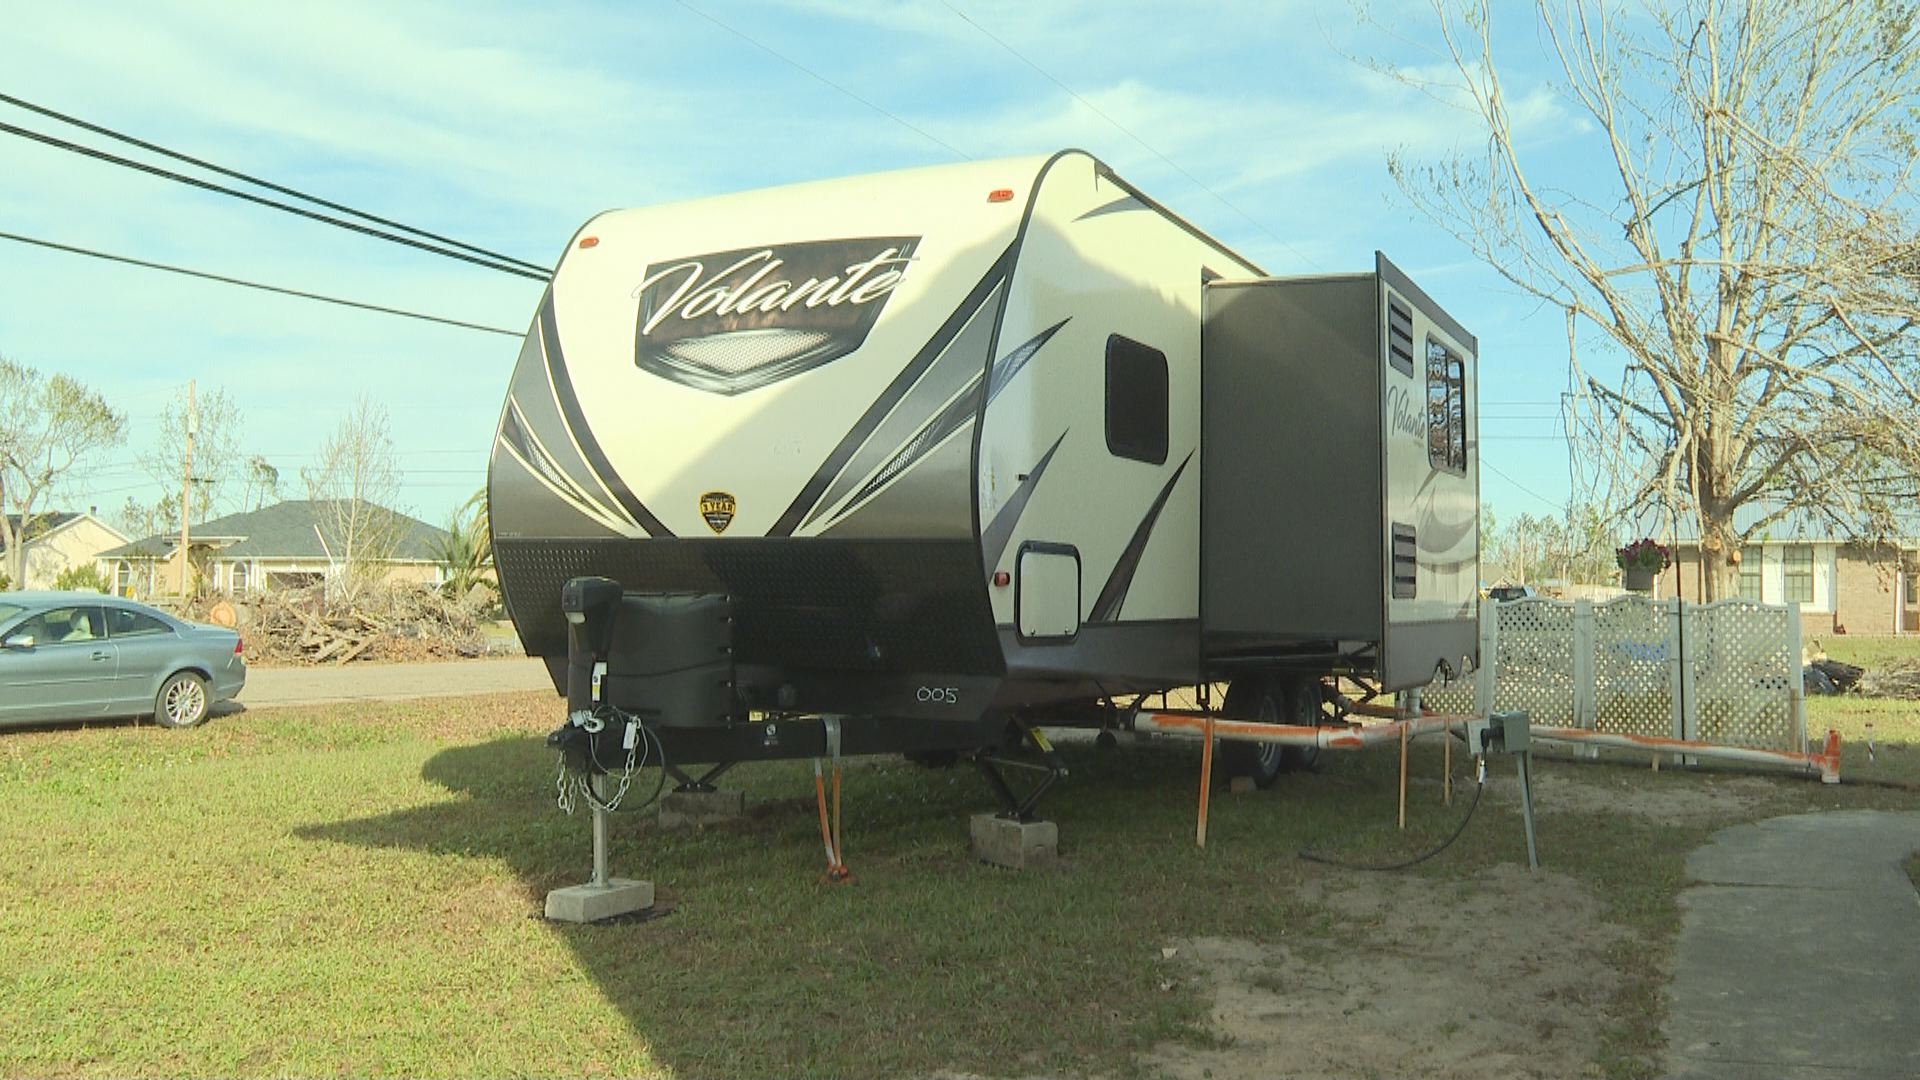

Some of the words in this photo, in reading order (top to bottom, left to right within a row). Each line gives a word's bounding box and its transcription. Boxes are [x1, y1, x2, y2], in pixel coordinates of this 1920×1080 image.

[631, 248, 920, 335] Volante
[1388, 385, 1425, 440] Volante
[916, 686, 959, 703] 005
